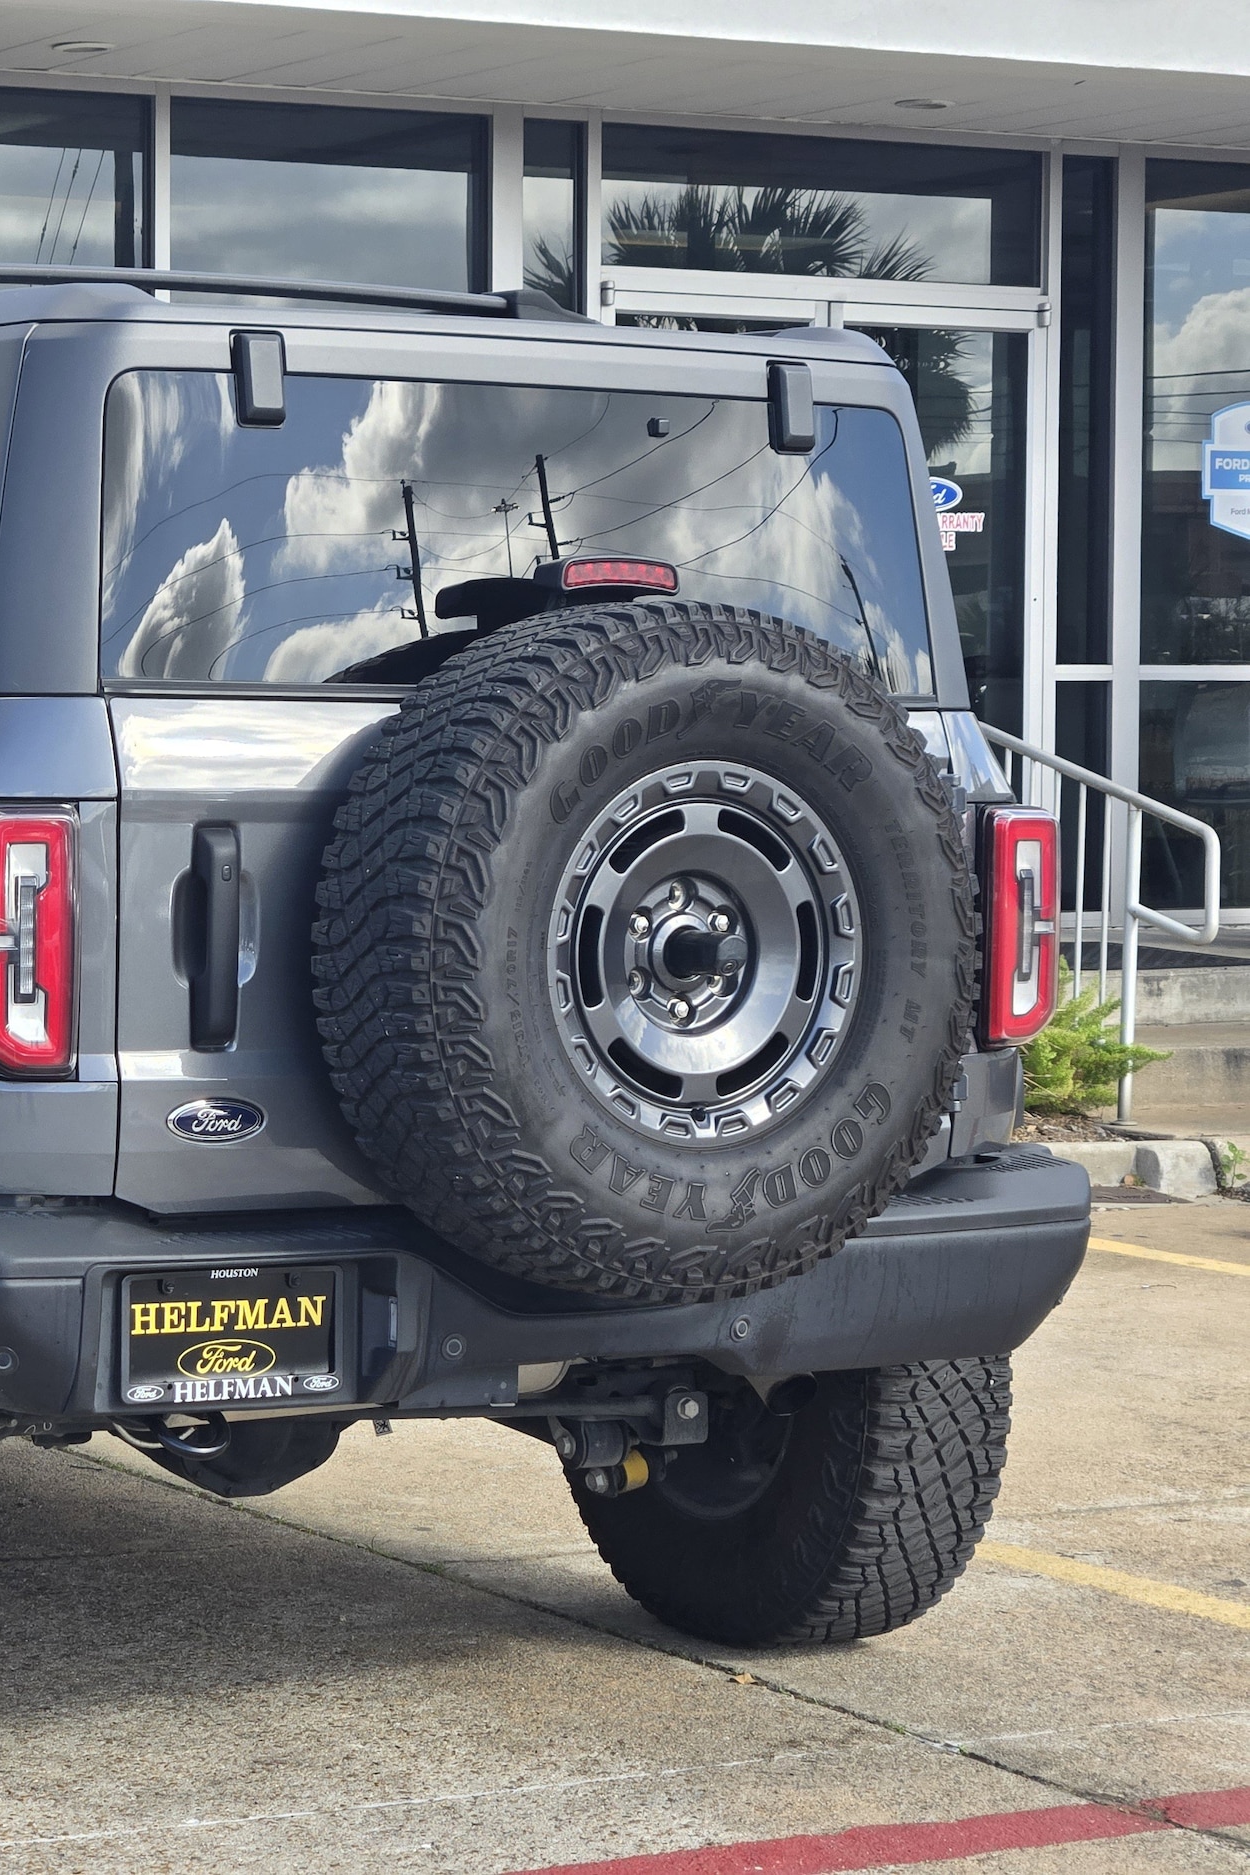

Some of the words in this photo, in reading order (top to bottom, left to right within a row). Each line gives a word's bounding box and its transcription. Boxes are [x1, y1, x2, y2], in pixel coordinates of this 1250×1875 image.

[1215, 457, 1250, 470] FORD
[938, 513, 984, 530] RRANTY
[1230, 507, 1246, 515] Ford
[885, 818, 928, 979] TERRITORY
[192, 1108, 243, 1132] Ford
[210, 1267, 259, 1279] HOUSTON
[131, 1295, 327, 1335] HELFMAN
[196, 1344, 257, 1374] Ford
[173, 1375, 294, 1404] HELFMAN
